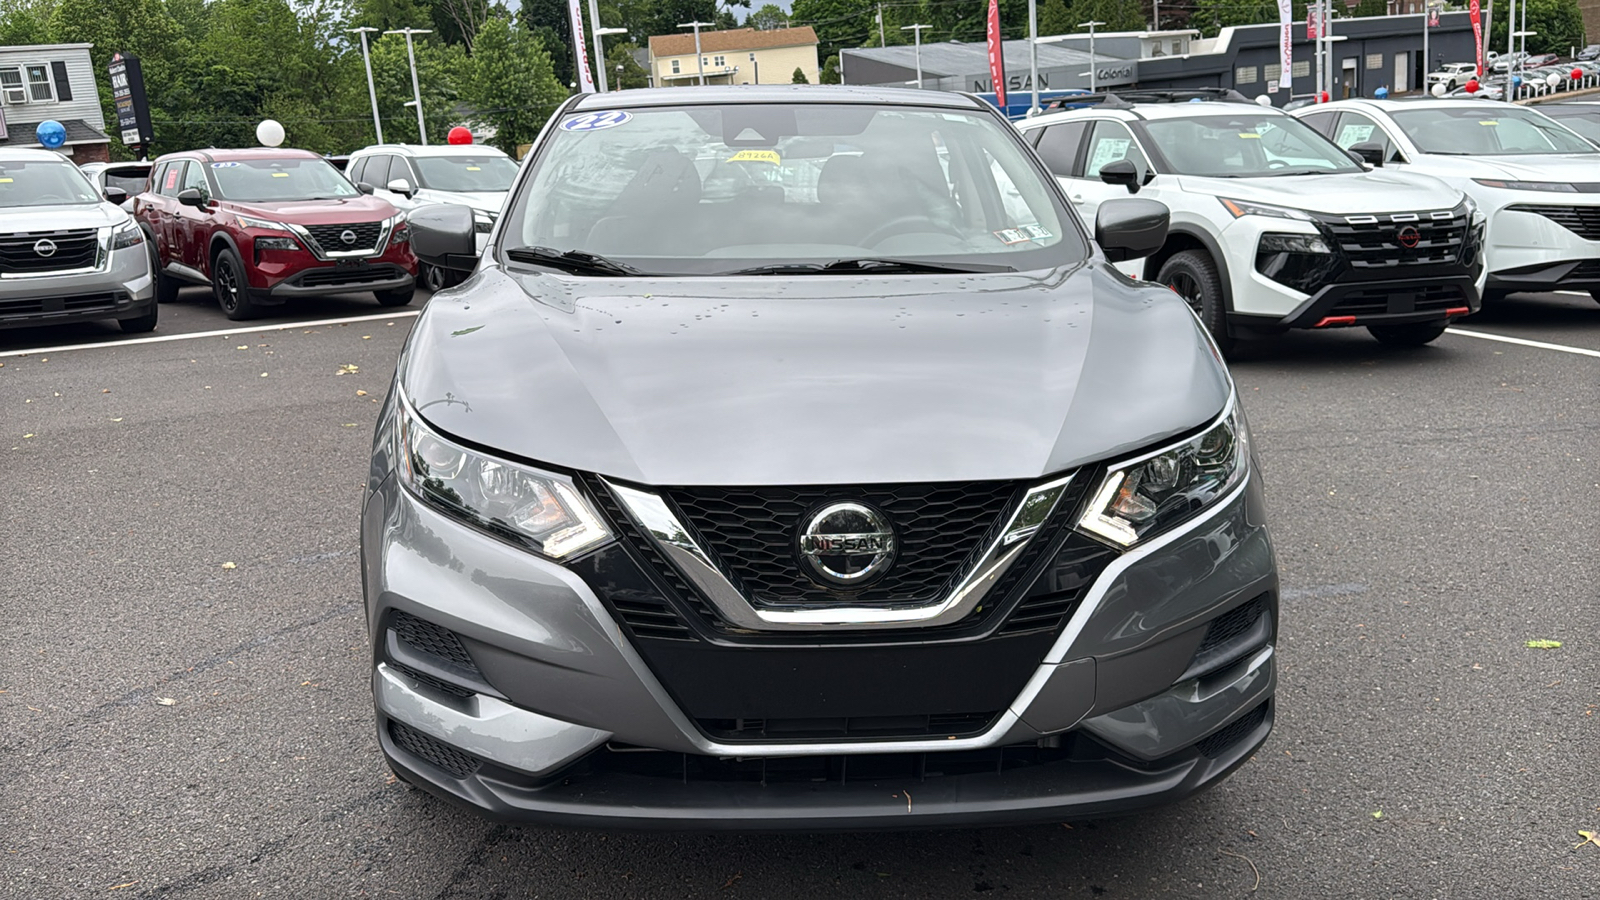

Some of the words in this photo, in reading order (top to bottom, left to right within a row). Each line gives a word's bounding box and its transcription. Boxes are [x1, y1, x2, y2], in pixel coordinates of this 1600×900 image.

[1097, 66, 1133, 81] Colonial
[974, 73, 1049, 93] NISAN
[565, 110, 622, 131] 22
[811, 537, 883, 552] NISSAN
